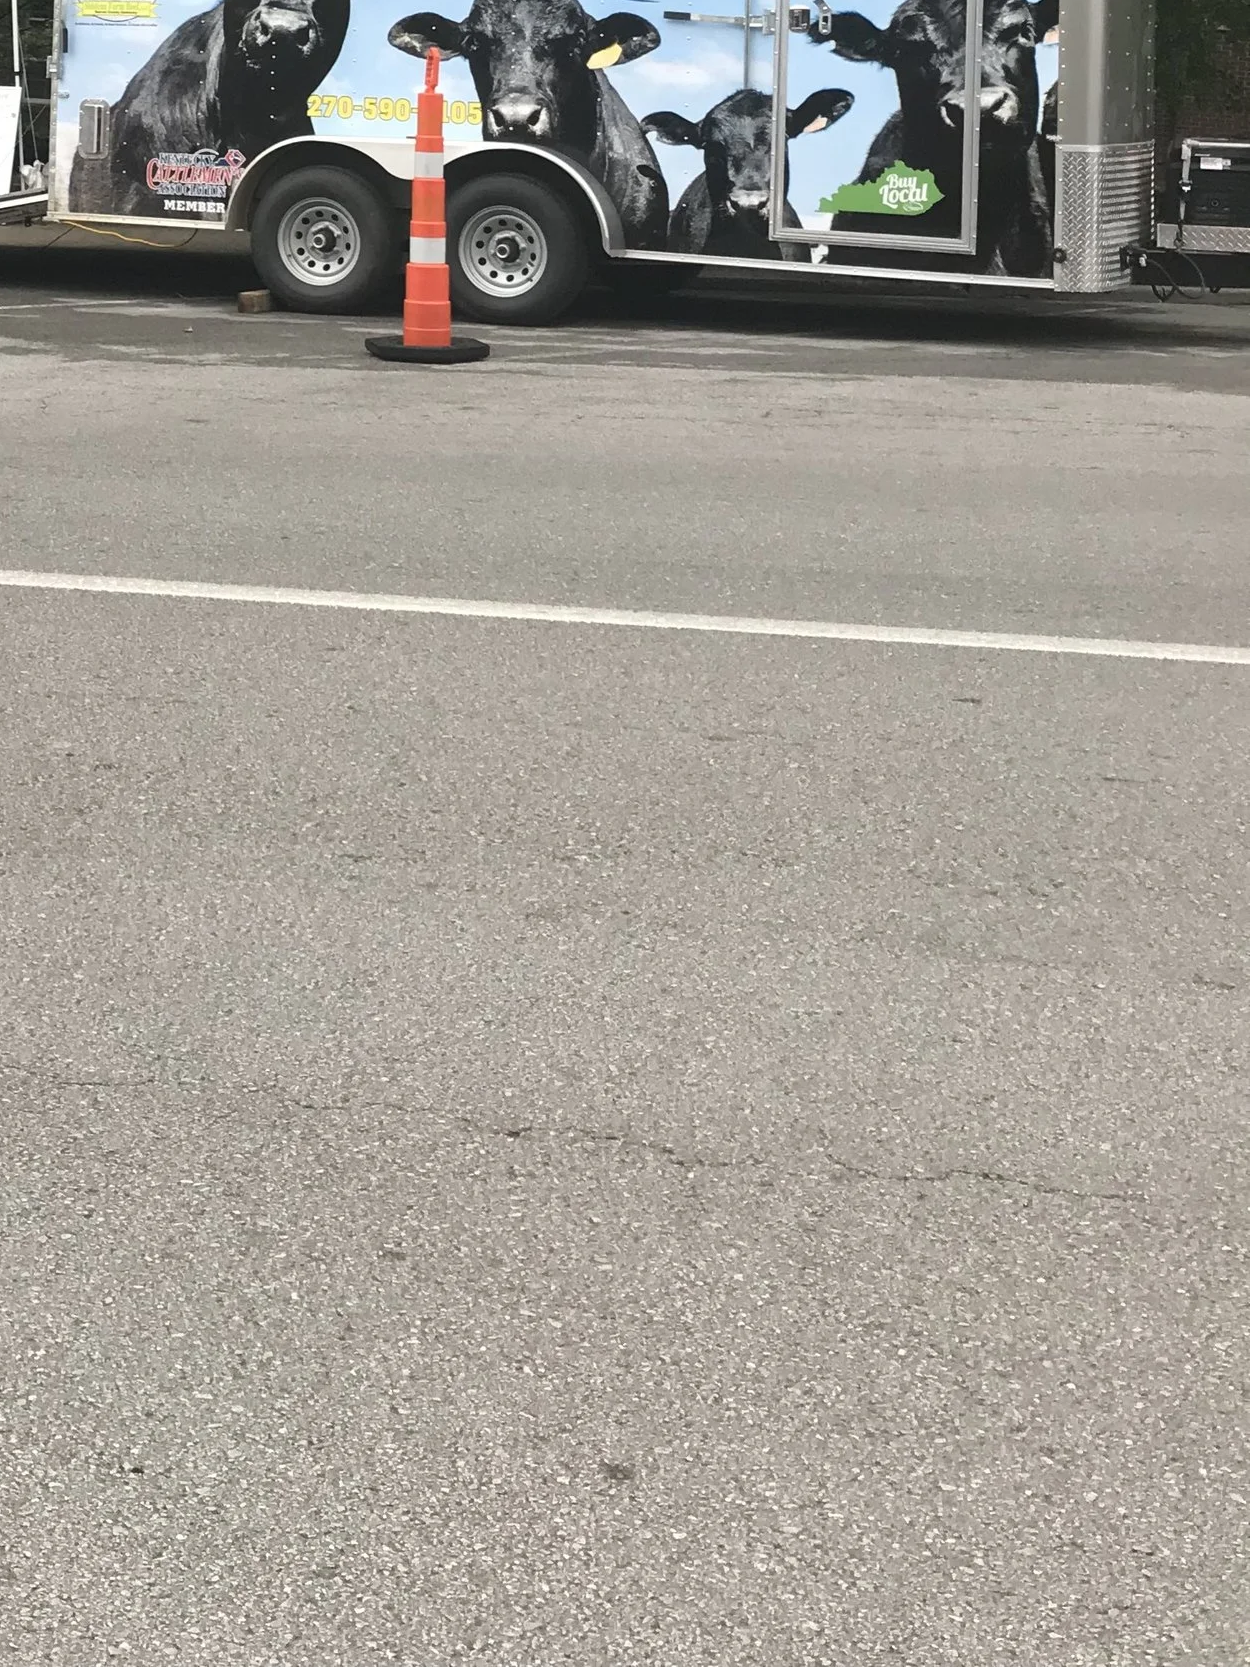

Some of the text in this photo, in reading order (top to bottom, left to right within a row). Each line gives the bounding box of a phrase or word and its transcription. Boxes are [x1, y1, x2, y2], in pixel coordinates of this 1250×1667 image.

[306, 94, 483, 125] 270-590-105
[157, 182, 227, 197] ASSOCIATION
[885, 173, 918, 191] Buy
[878, 183, 929, 210] Local
[163, 199, 226, 214] MEMBER
